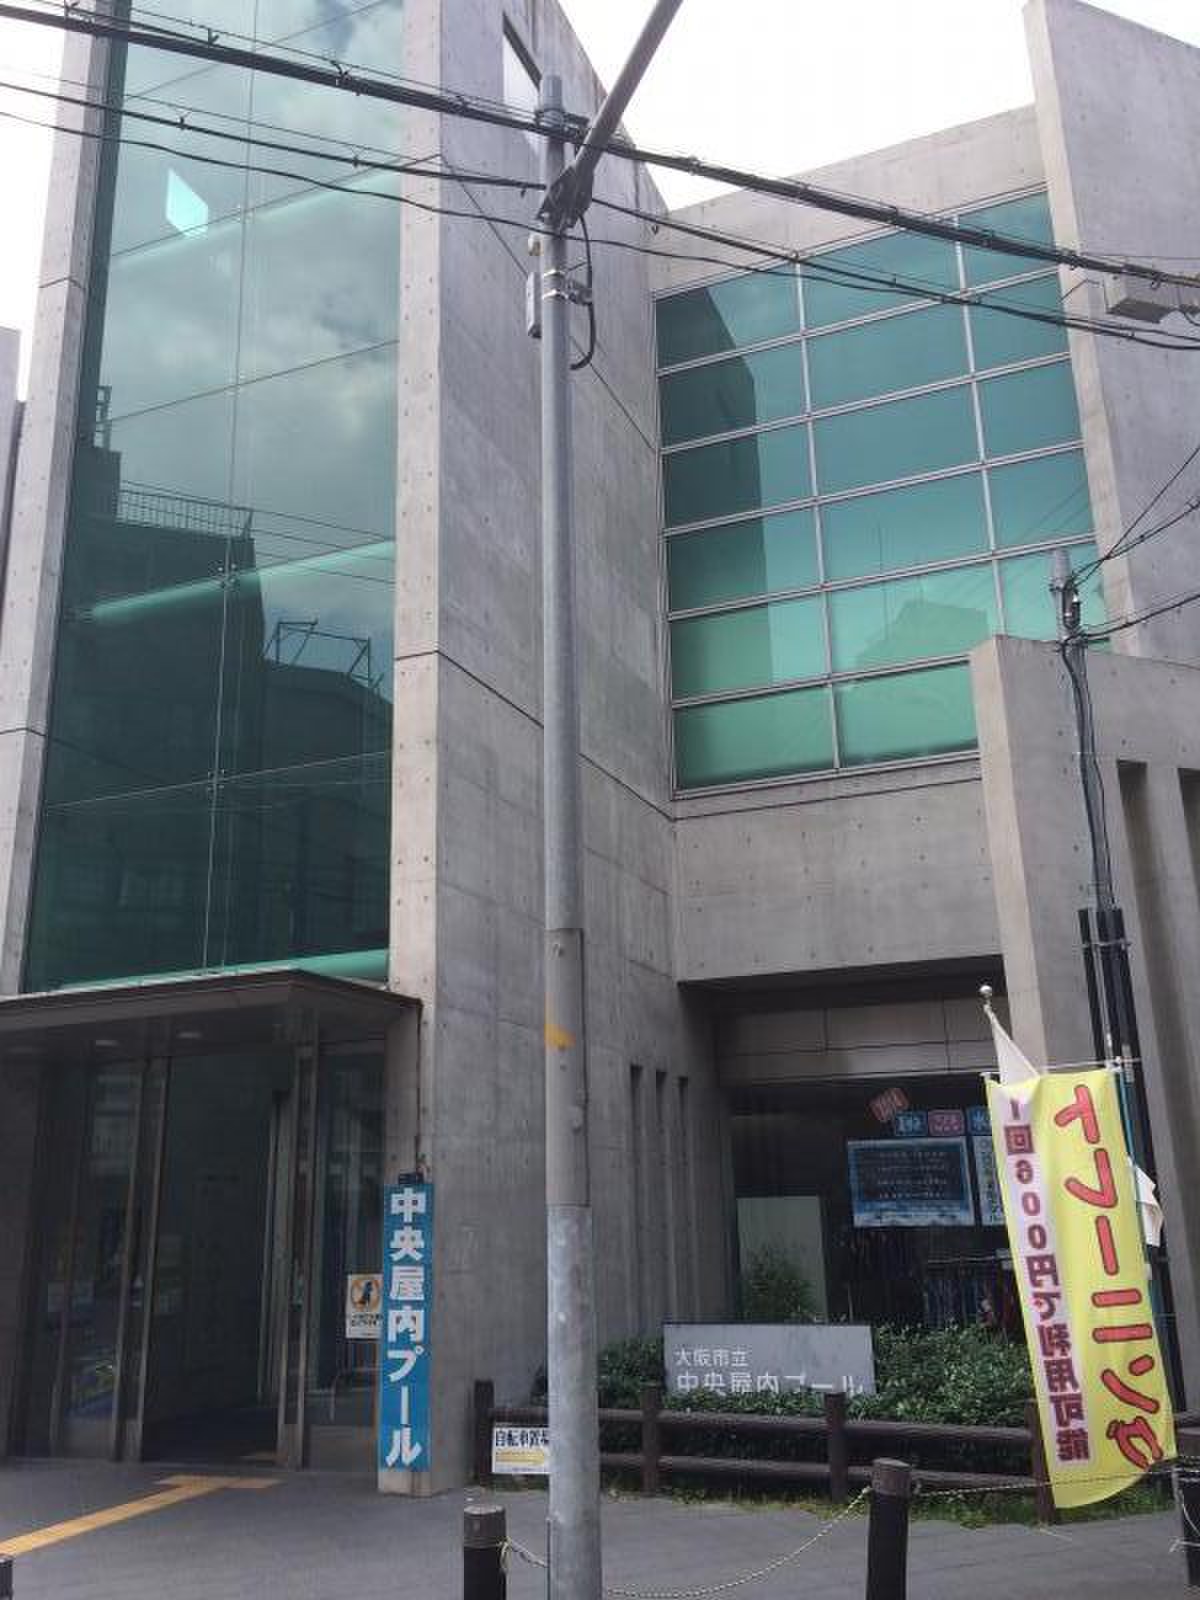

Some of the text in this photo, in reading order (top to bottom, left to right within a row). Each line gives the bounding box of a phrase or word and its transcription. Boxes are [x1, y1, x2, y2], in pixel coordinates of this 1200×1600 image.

[386, 1187, 427, 1467] 中央屋内プール
[674, 1347, 749, 1367] 大阪市立
